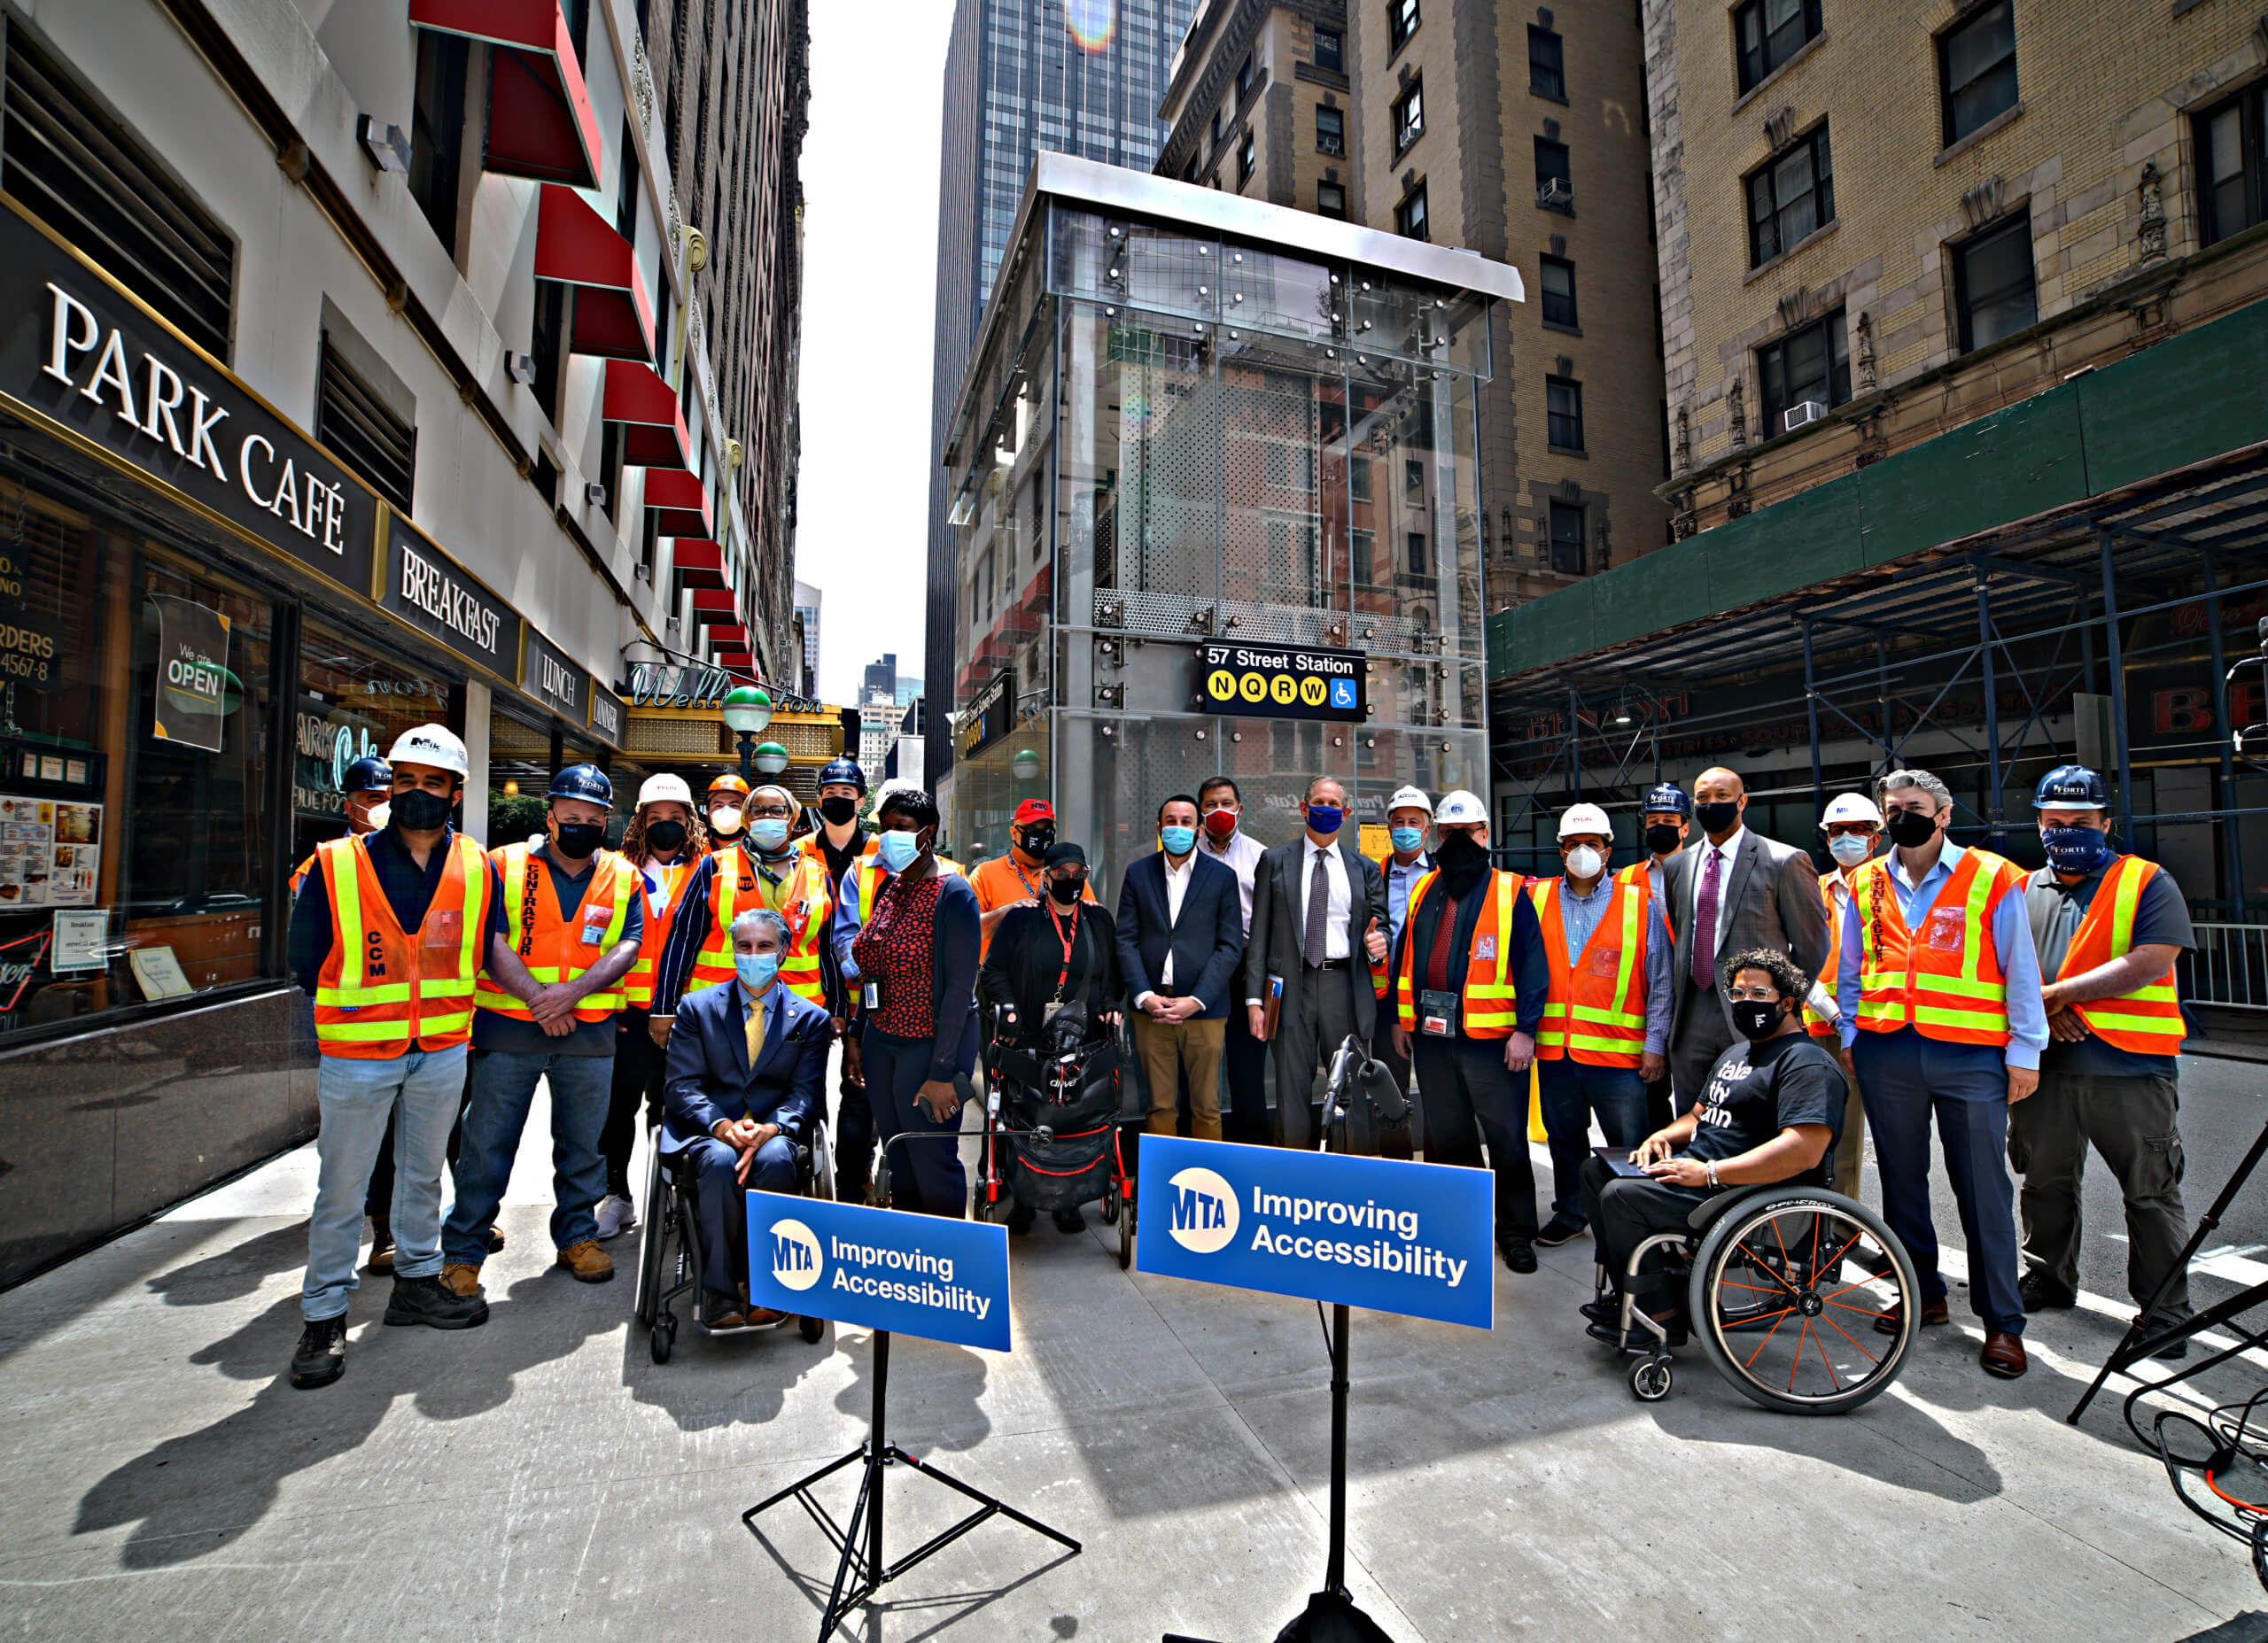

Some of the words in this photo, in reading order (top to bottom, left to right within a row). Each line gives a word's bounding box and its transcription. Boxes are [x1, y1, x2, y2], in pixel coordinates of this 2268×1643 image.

[43, 282, 230, 482] PARK
[240, 434, 345, 555] CAFÉ
[401, 546, 500, 655] BREAKFAST
[168, 659, 218, 696] OPEN
[179, 642, 195, 661] We
[197, 654, 212, 666] are
[1208, 647, 1230, 664] 57
[1237, 649, 1289, 669] Street
[1295, 655, 1353, 674] Station
[542, 655, 576, 707] LUNCH
[631, 665, 824, 714] Welliton
[594, 694, 617, 734] DINNER
[581, 779, 605, 793] FORTE
[520, 864, 539, 956] CONTRACTOR
[368, 931, 385, 977] CCM
[1718, 1060, 1752, 1081] take
[1253, 1186, 1418, 1241] Improving
[831, 1236, 954, 1283] Improving
[1250, 1224, 1468, 1287] Accessibility
[832, 1267, 991, 1320] Accessibility
